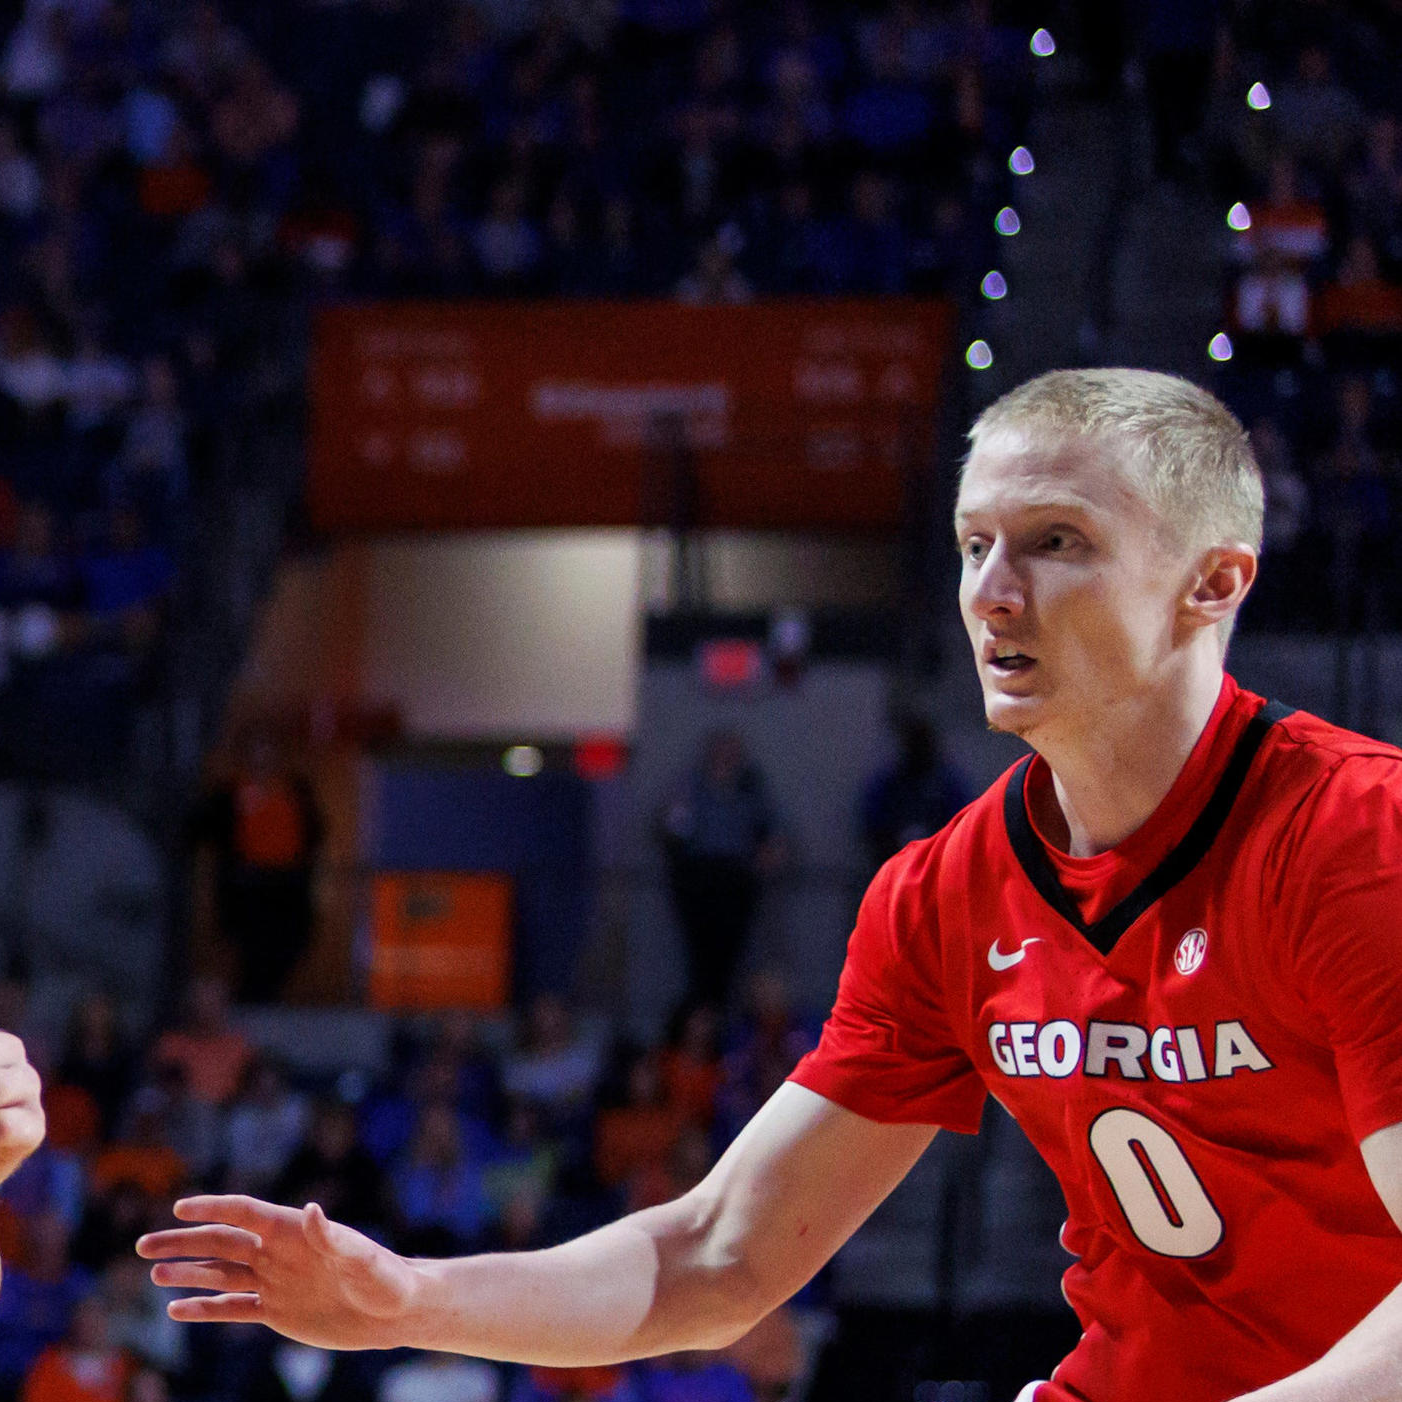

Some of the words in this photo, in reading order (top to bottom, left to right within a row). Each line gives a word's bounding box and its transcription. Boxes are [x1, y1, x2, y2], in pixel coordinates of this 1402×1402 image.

[1176, 930, 1206, 973] SEC
[988, 1019, 1274, 1082] GEORGIA
[1089, 1105, 1225, 1259] 0
